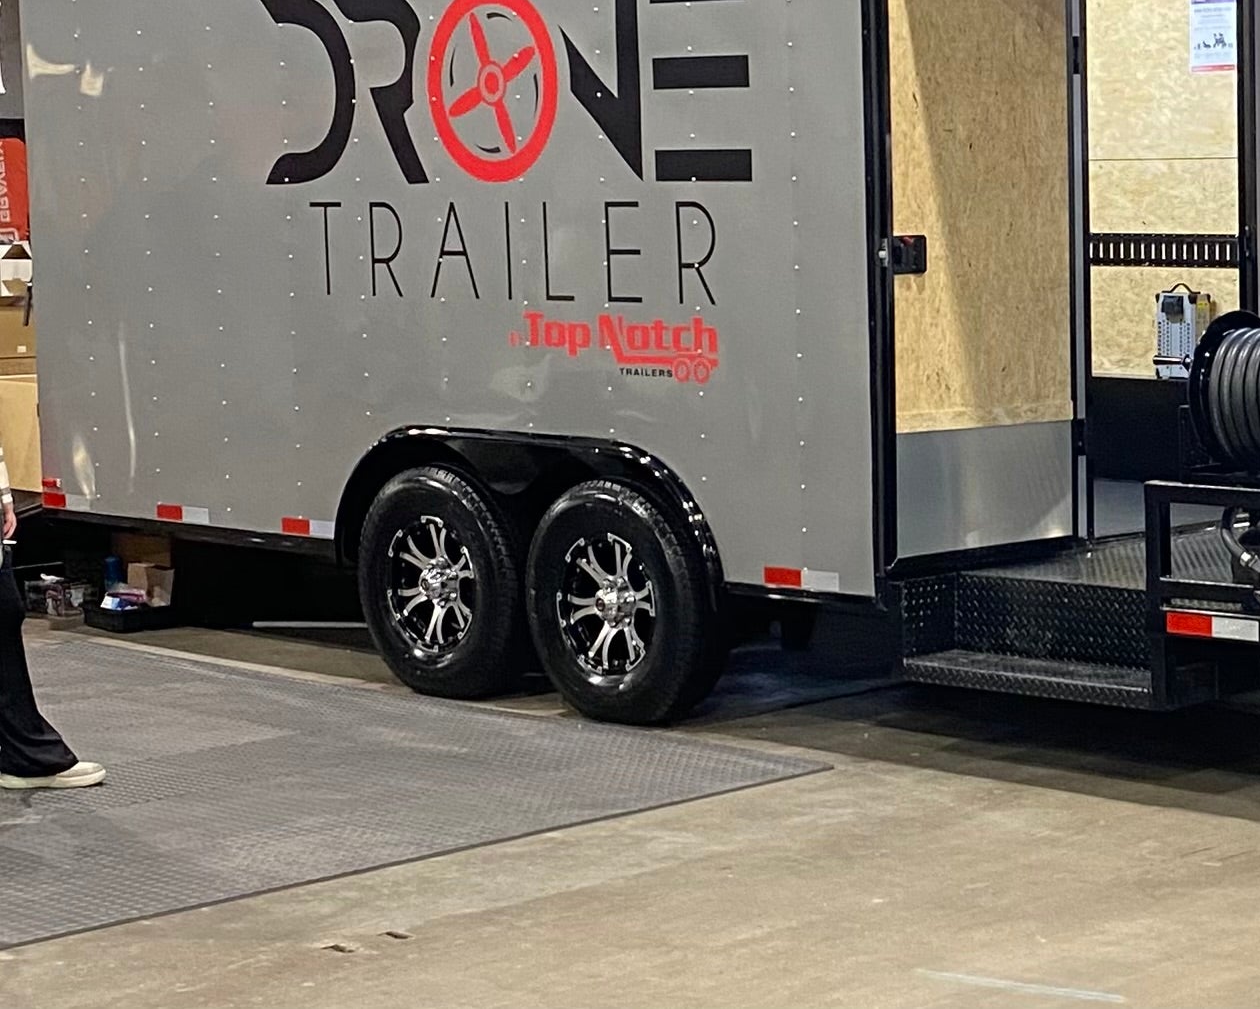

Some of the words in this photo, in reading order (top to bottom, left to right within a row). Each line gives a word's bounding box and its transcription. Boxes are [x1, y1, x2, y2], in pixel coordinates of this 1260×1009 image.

[308, 201, 716, 305] TRAILER
[523, 310, 592, 357] Top
[597, 312, 719, 365] Notch
[619, 367, 673, 378] TRAILERS
